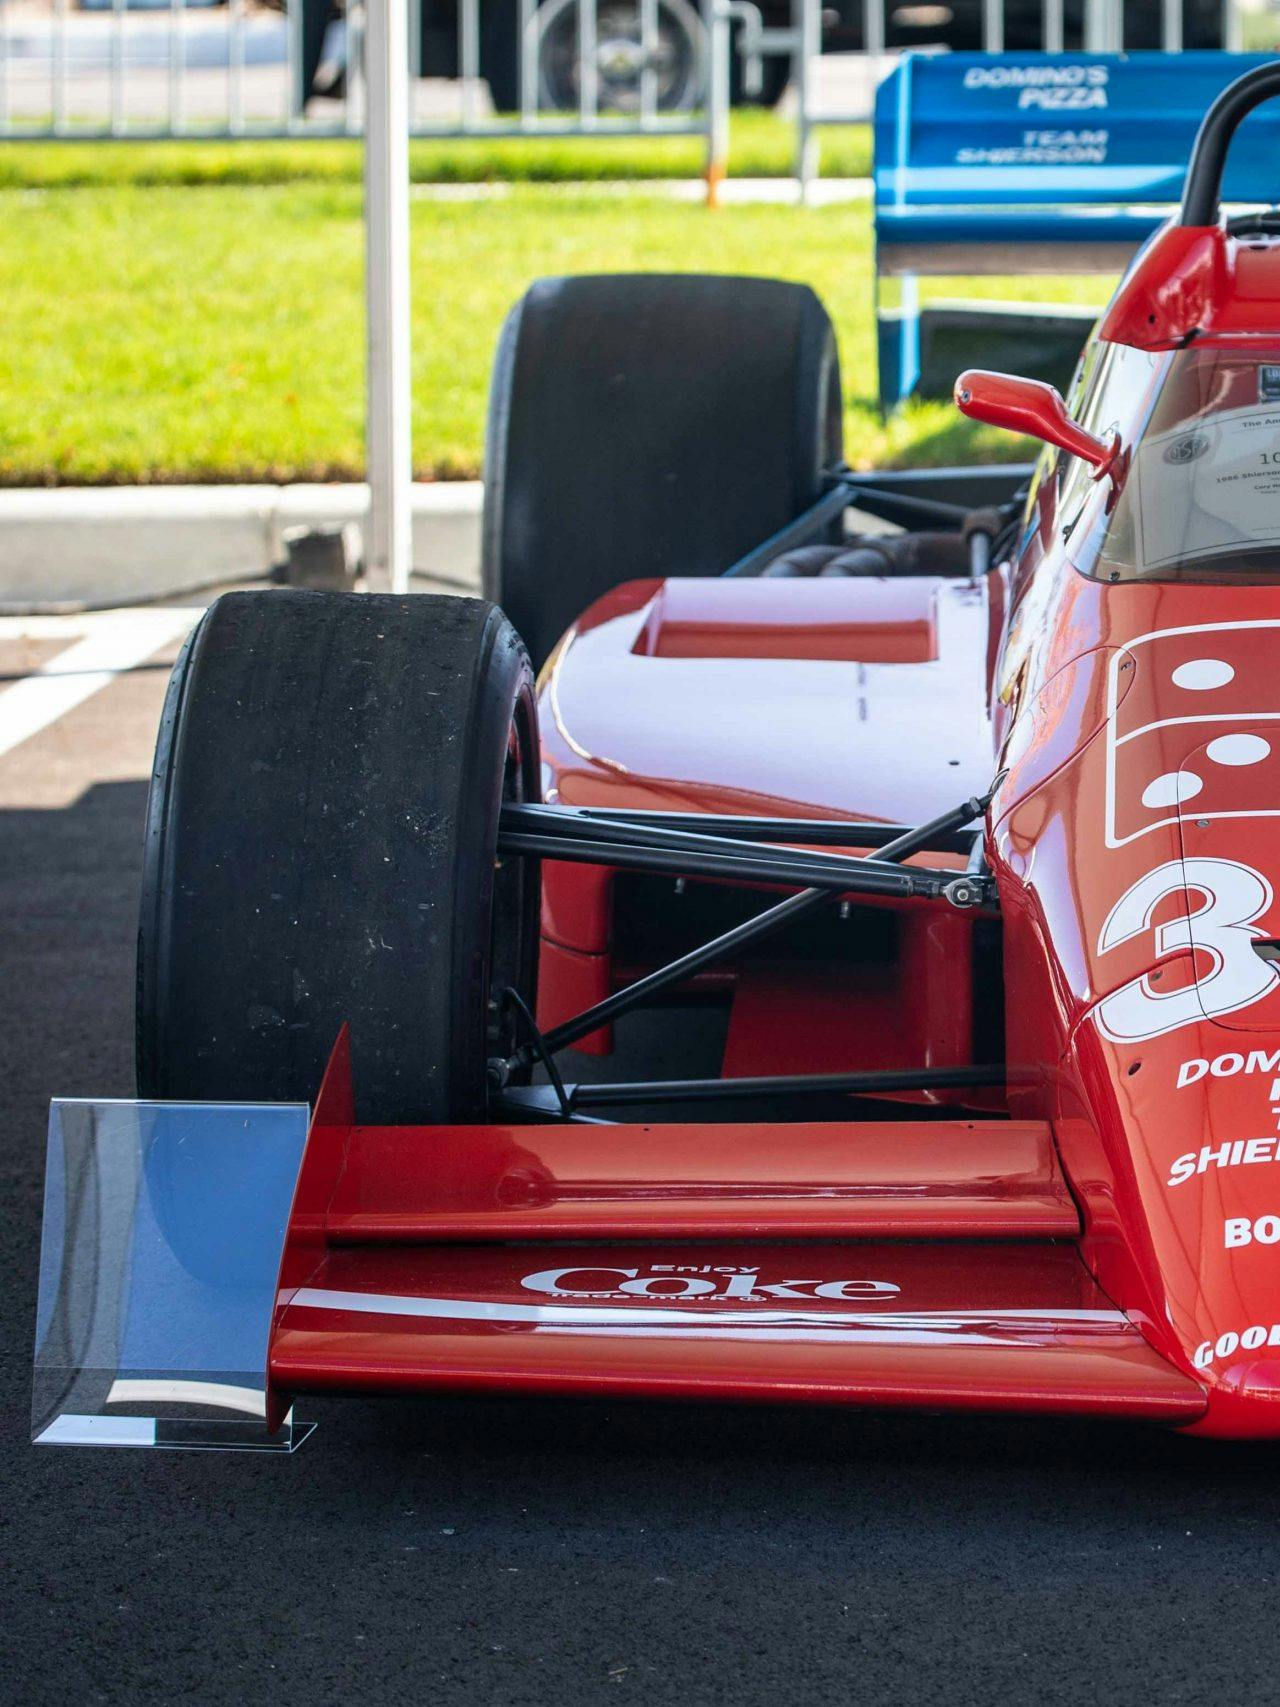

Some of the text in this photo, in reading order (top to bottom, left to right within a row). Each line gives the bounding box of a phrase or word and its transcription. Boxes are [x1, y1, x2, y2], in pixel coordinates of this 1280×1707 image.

[1018, 87, 1109, 109] PIZZA
[1023, 129, 1109, 145] TEAM
[1242, 420, 1262, 428] The
[650, 1264, 760, 1274] Enjoy
[520, 1266, 901, 1301] Coke
